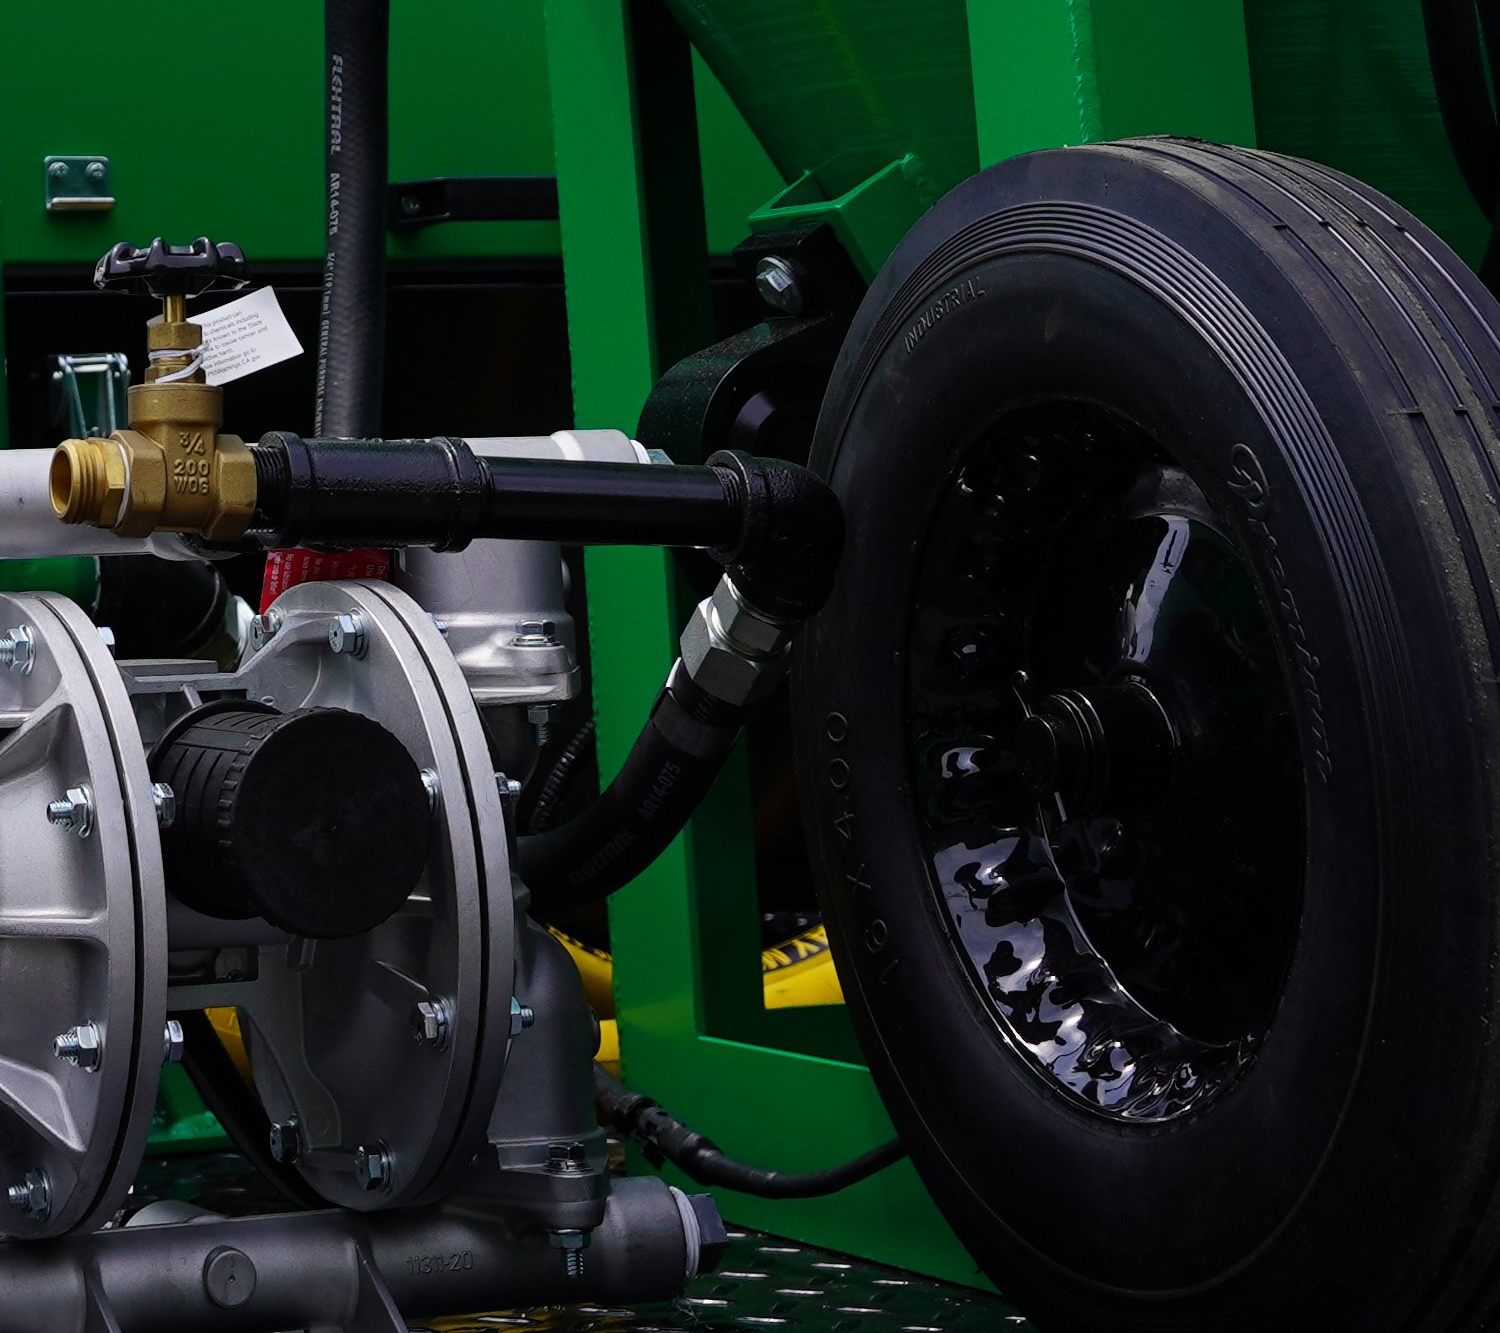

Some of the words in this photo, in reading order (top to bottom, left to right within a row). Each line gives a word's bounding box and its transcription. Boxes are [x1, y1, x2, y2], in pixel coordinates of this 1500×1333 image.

[331, 54, 343, 155] FLEXTRAL
[902, 276, 987, 354] INDUSTRIAL
[319, 319, 330, 357] GENERAL
[316, 358, 327, 394] PURPOSE
[179, 432, 206, 456] 3/4
[174, 459, 210, 475] 200
[638, 760, 681, 821] AR14-075
